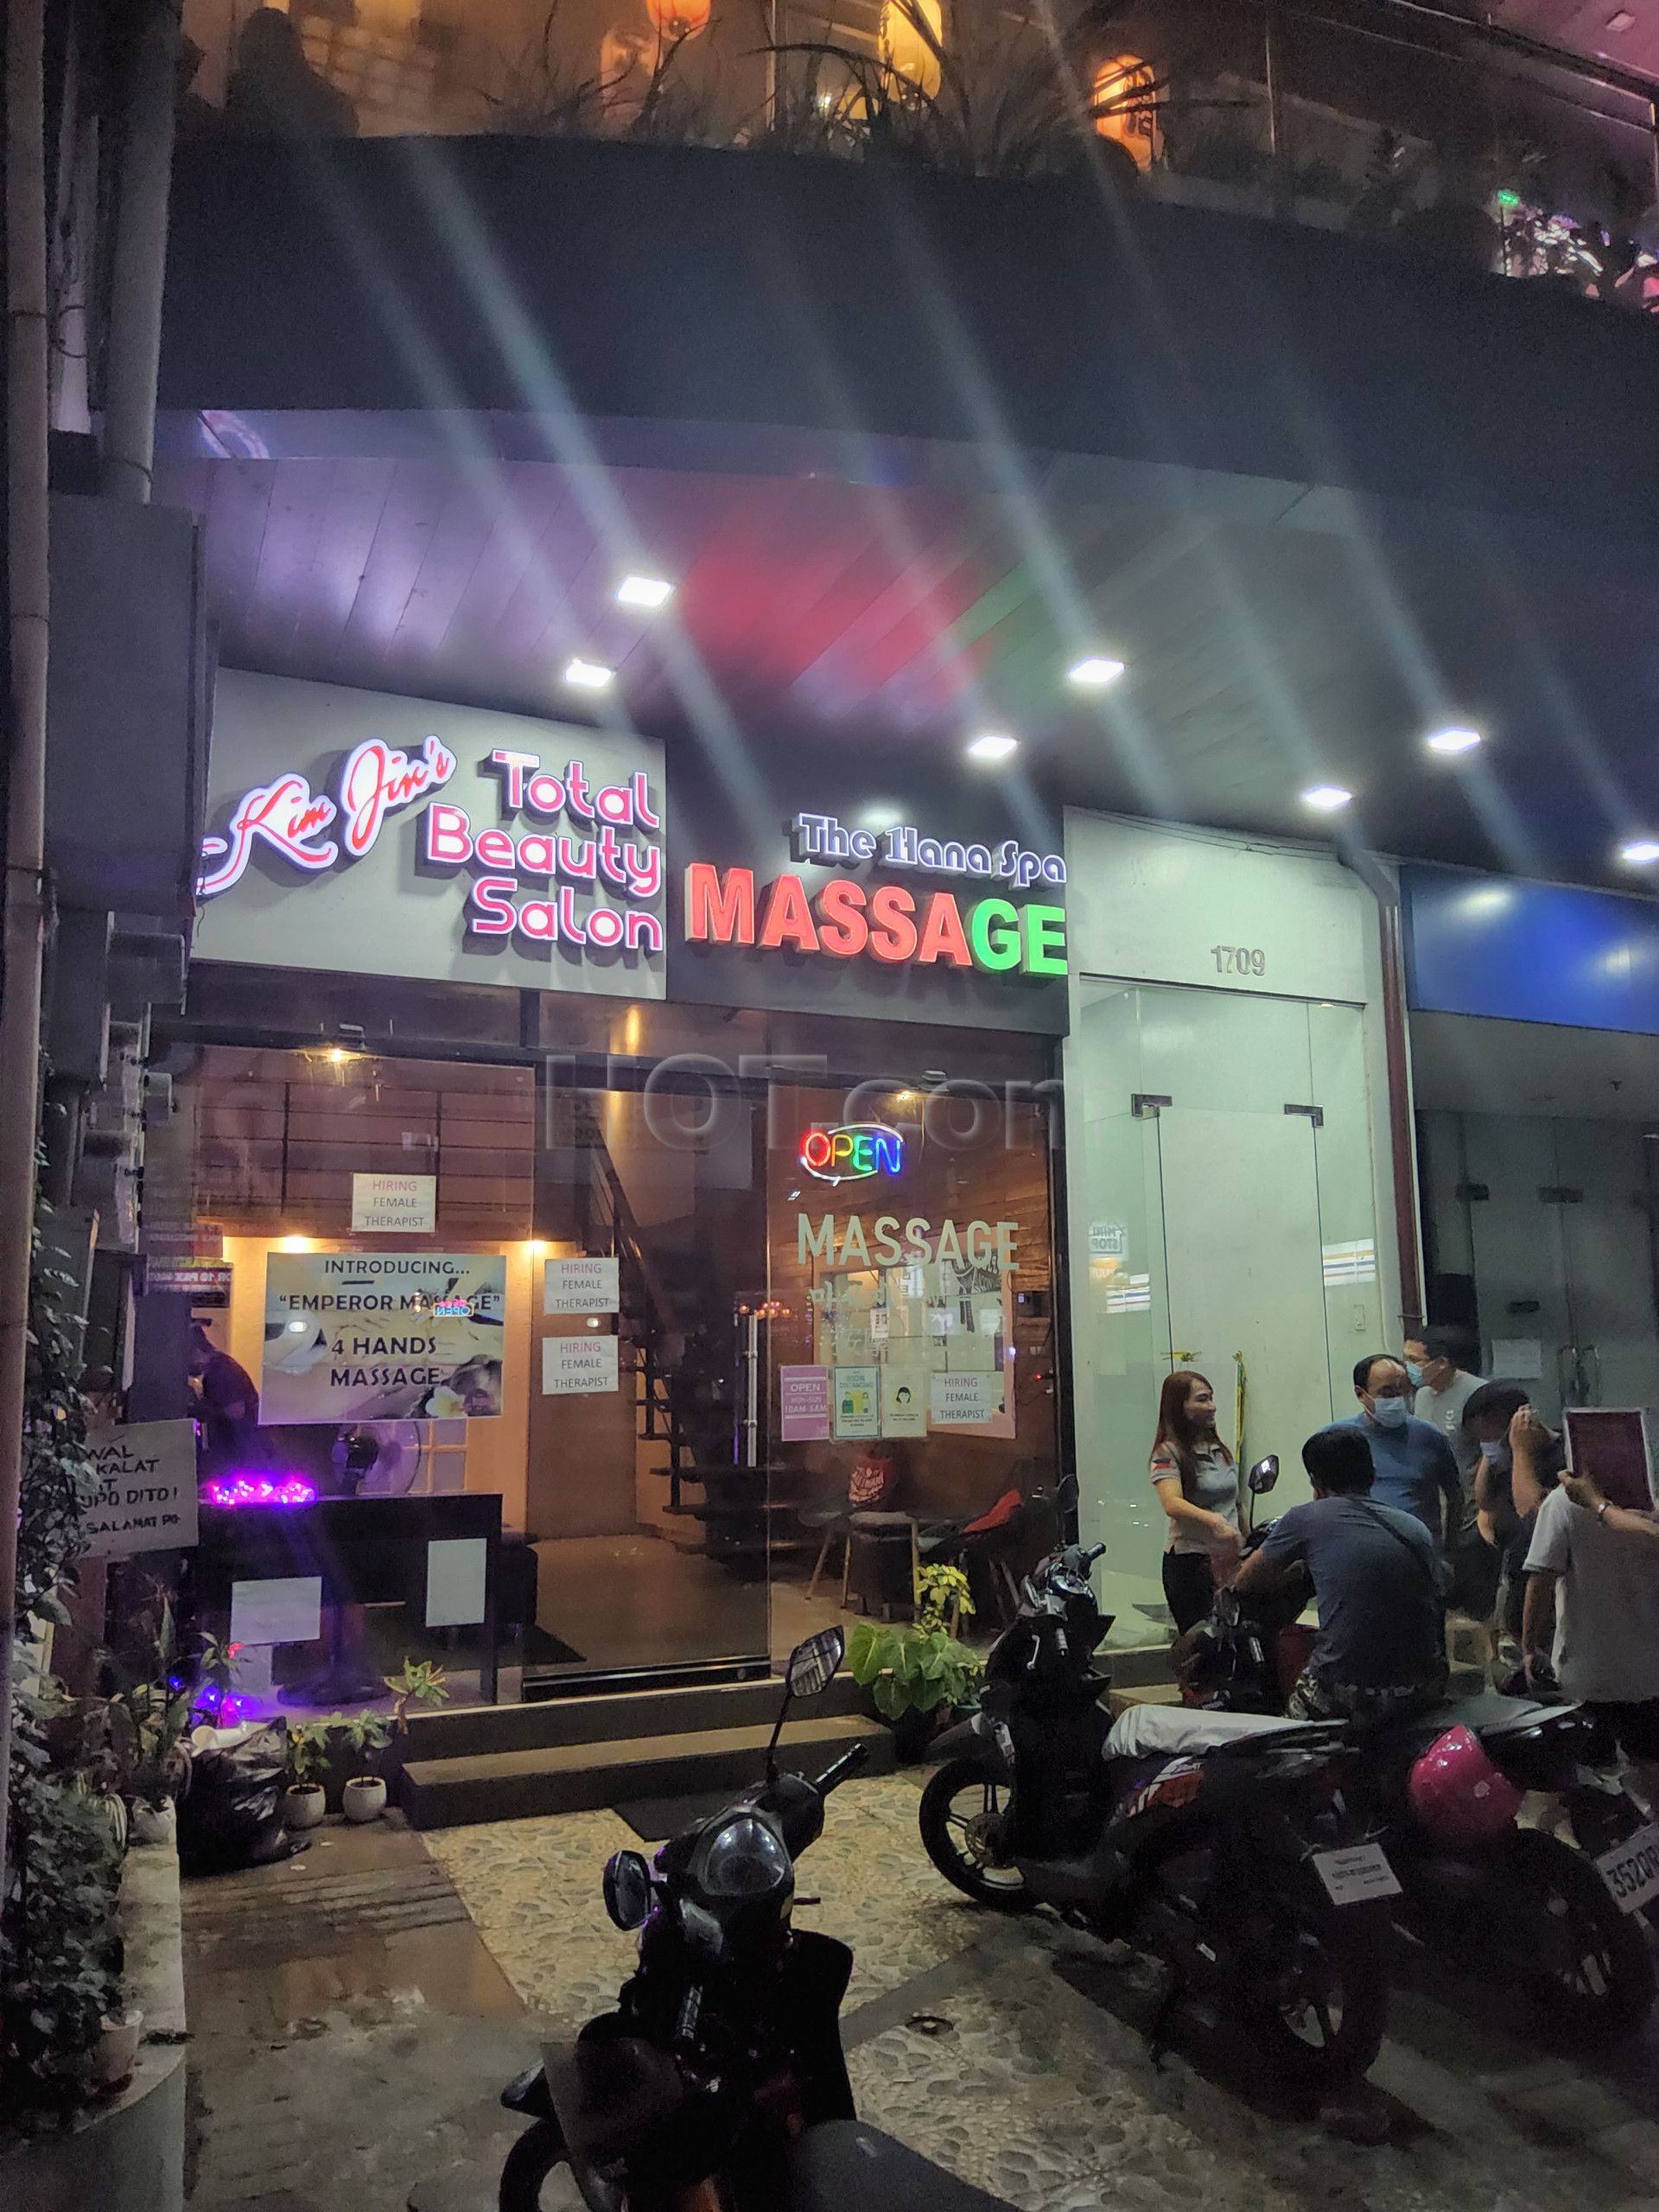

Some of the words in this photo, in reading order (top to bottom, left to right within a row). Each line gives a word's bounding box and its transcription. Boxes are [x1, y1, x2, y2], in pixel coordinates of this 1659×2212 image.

[492, 748, 659, 829] Total
[199, 773, 338, 895] Kim
[428, 802, 660, 898] Beauty
[799, 812, 876, 859] The
[884, 826, 991, 874] Hana
[999, 840, 1067, 887] Spa
[472, 875, 663, 950] Salon
[687, 862, 1068, 976] MASSAGE
[1210, 945, 1266, 976] 1709
[804, 1132, 901, 1173] OPEN
[372, 1179, 417, 1192] HIRING
[373, 1197, 417, 1208] FEMALE
[365, 1215, 425, 1227] THERAPIST
[798, 1212, 1020, 1271] MASSAGE
[324, 1259, 470, 1274] INTRODUCING...
[562, 1263, 602, 1274] HIRING
[563, 1280, 602, 1289] FEMALE
[399, 1294, 500, 1310] MAGE”
[555, 1298, 609, 1308] THERAPIST
[332, 1339, 345, 1355] 4
[353, 1336, 436, 1355] HANDS
[560, 1342, 601, 1352] HIRING
[562, 1358, 601, 1369] FEMALE
[330, 1367, 441, 1386] MASSAGE
[554, 1377, 609, 1389] THERAPIST
[944, 1377, 978, 1388] HIRING
[790, 1383, 821, 1392] OPEN
[945, 1393, 979, 1402] FEMALE
[940, 1409, 985, 1420] THERAPIST
[96, 1459, 161, 1475] KALAT
[86, 1516, 157, 1535] SALAMAT
